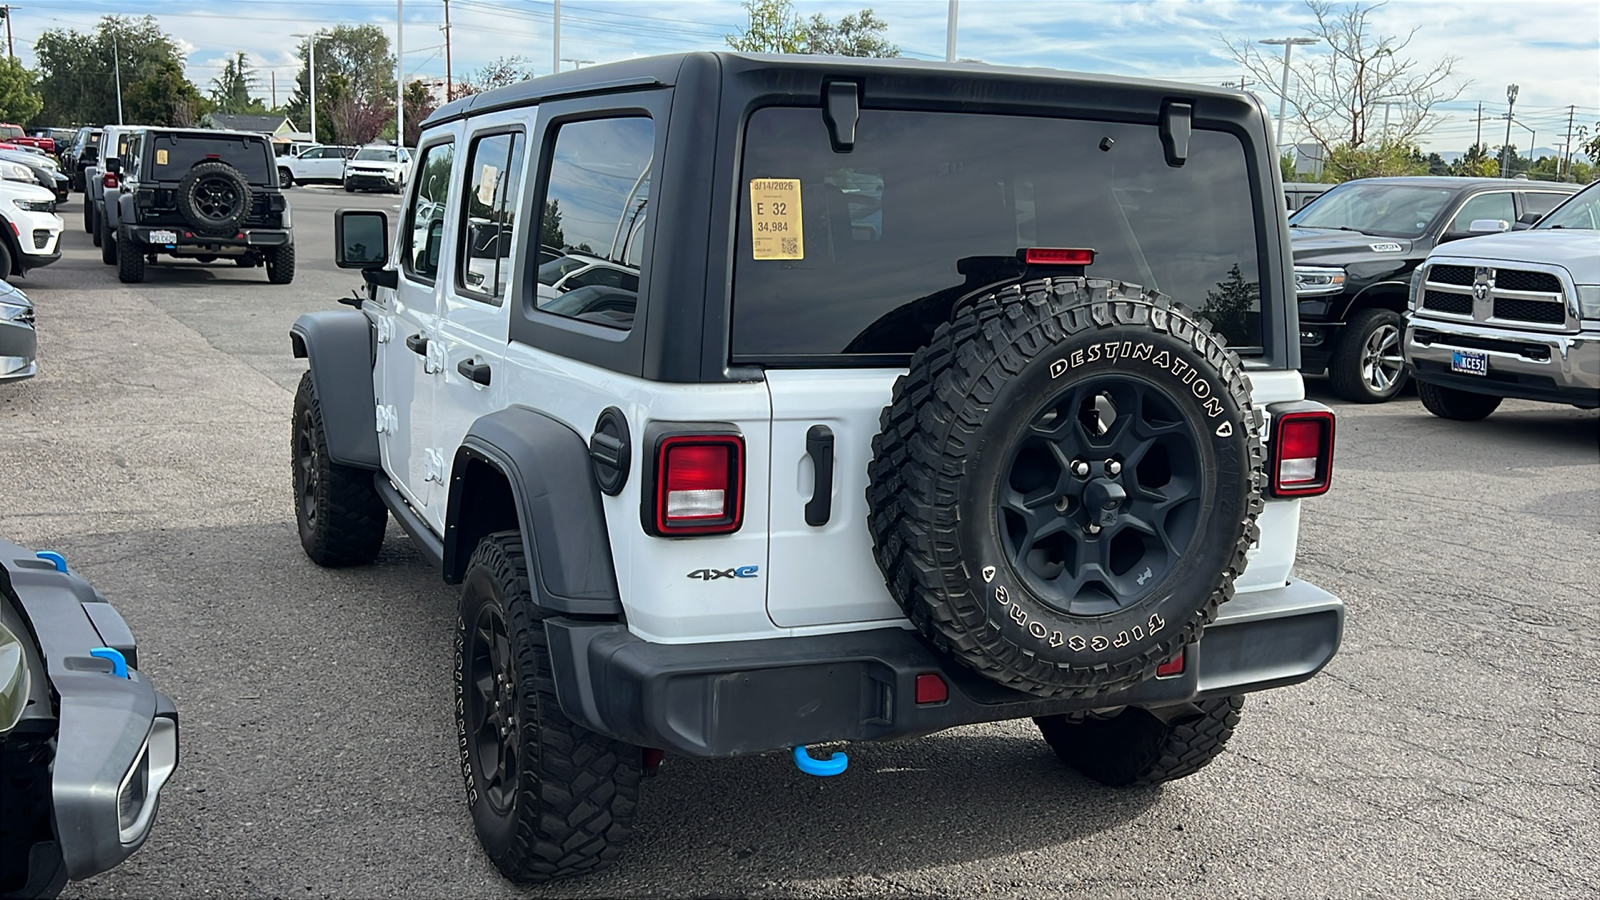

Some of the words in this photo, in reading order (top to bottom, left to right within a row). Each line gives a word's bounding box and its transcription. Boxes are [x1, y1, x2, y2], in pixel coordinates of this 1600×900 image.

[757, 202, 764, 215] E
[772, 202, 787, 216] 32
[757, 221, 788, 233] 34,984
[1050, 342, 1224, 417] DESTINATION
[455, 633, 478, 806] DESTINATION
